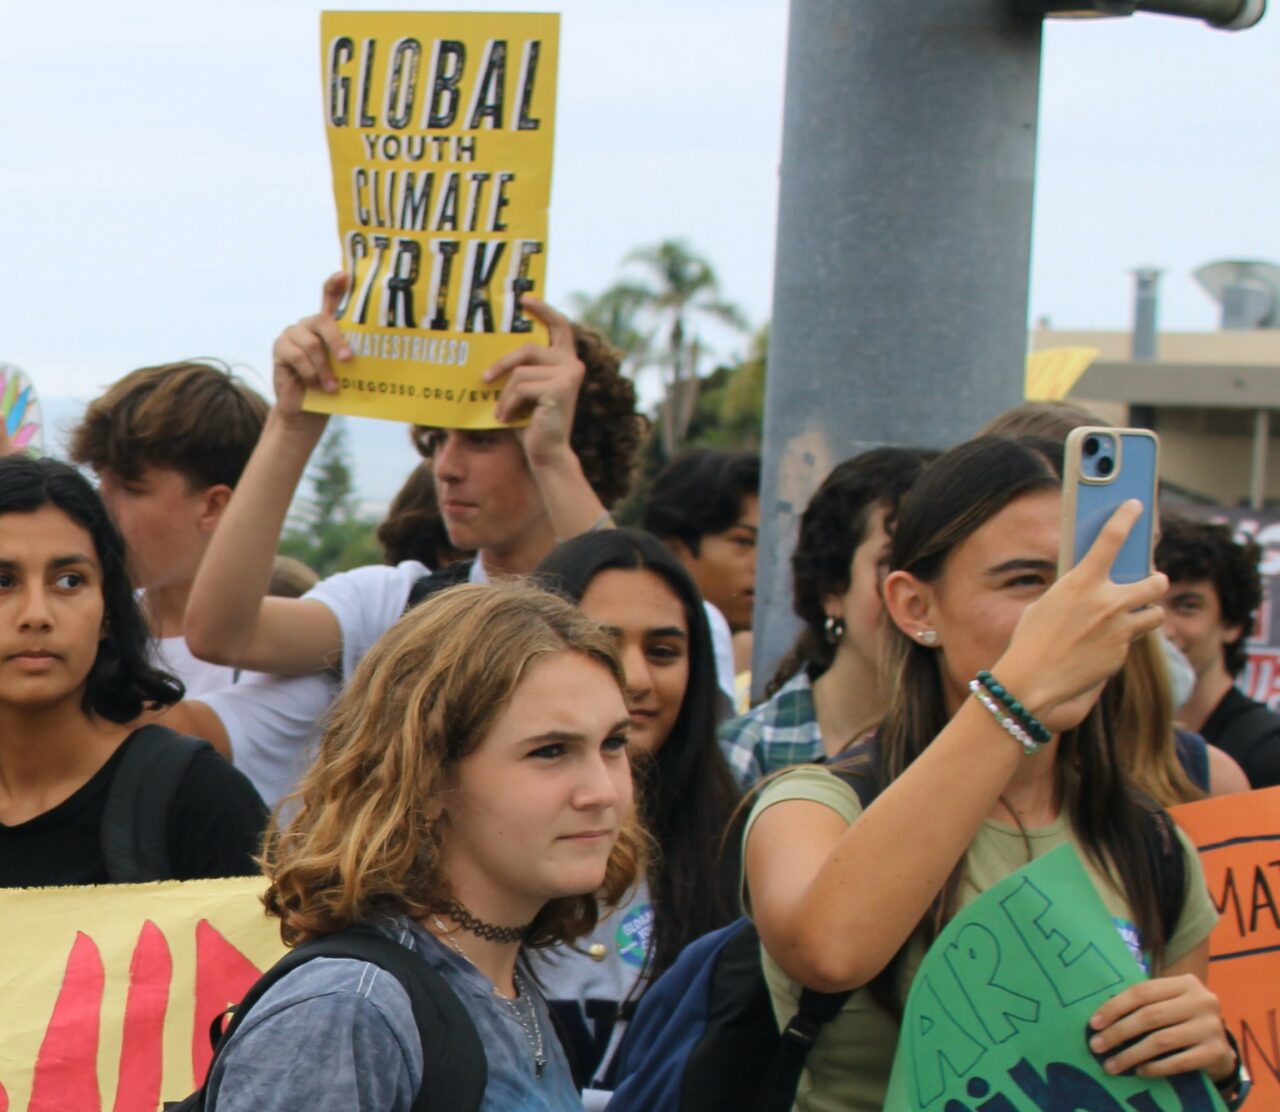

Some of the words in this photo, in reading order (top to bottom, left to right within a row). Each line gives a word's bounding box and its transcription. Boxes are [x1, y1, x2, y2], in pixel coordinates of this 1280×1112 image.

[326, 36, 542, 131] GLOBAL
[362, 134, 477, 162] YOUTH
[352, 167, 515, 232] CLIMATE
[334, 231, 545, 334] STRIKE
[1208, 859, 1280, 937] MA
[914, 877, 1124, 1108] ARE
